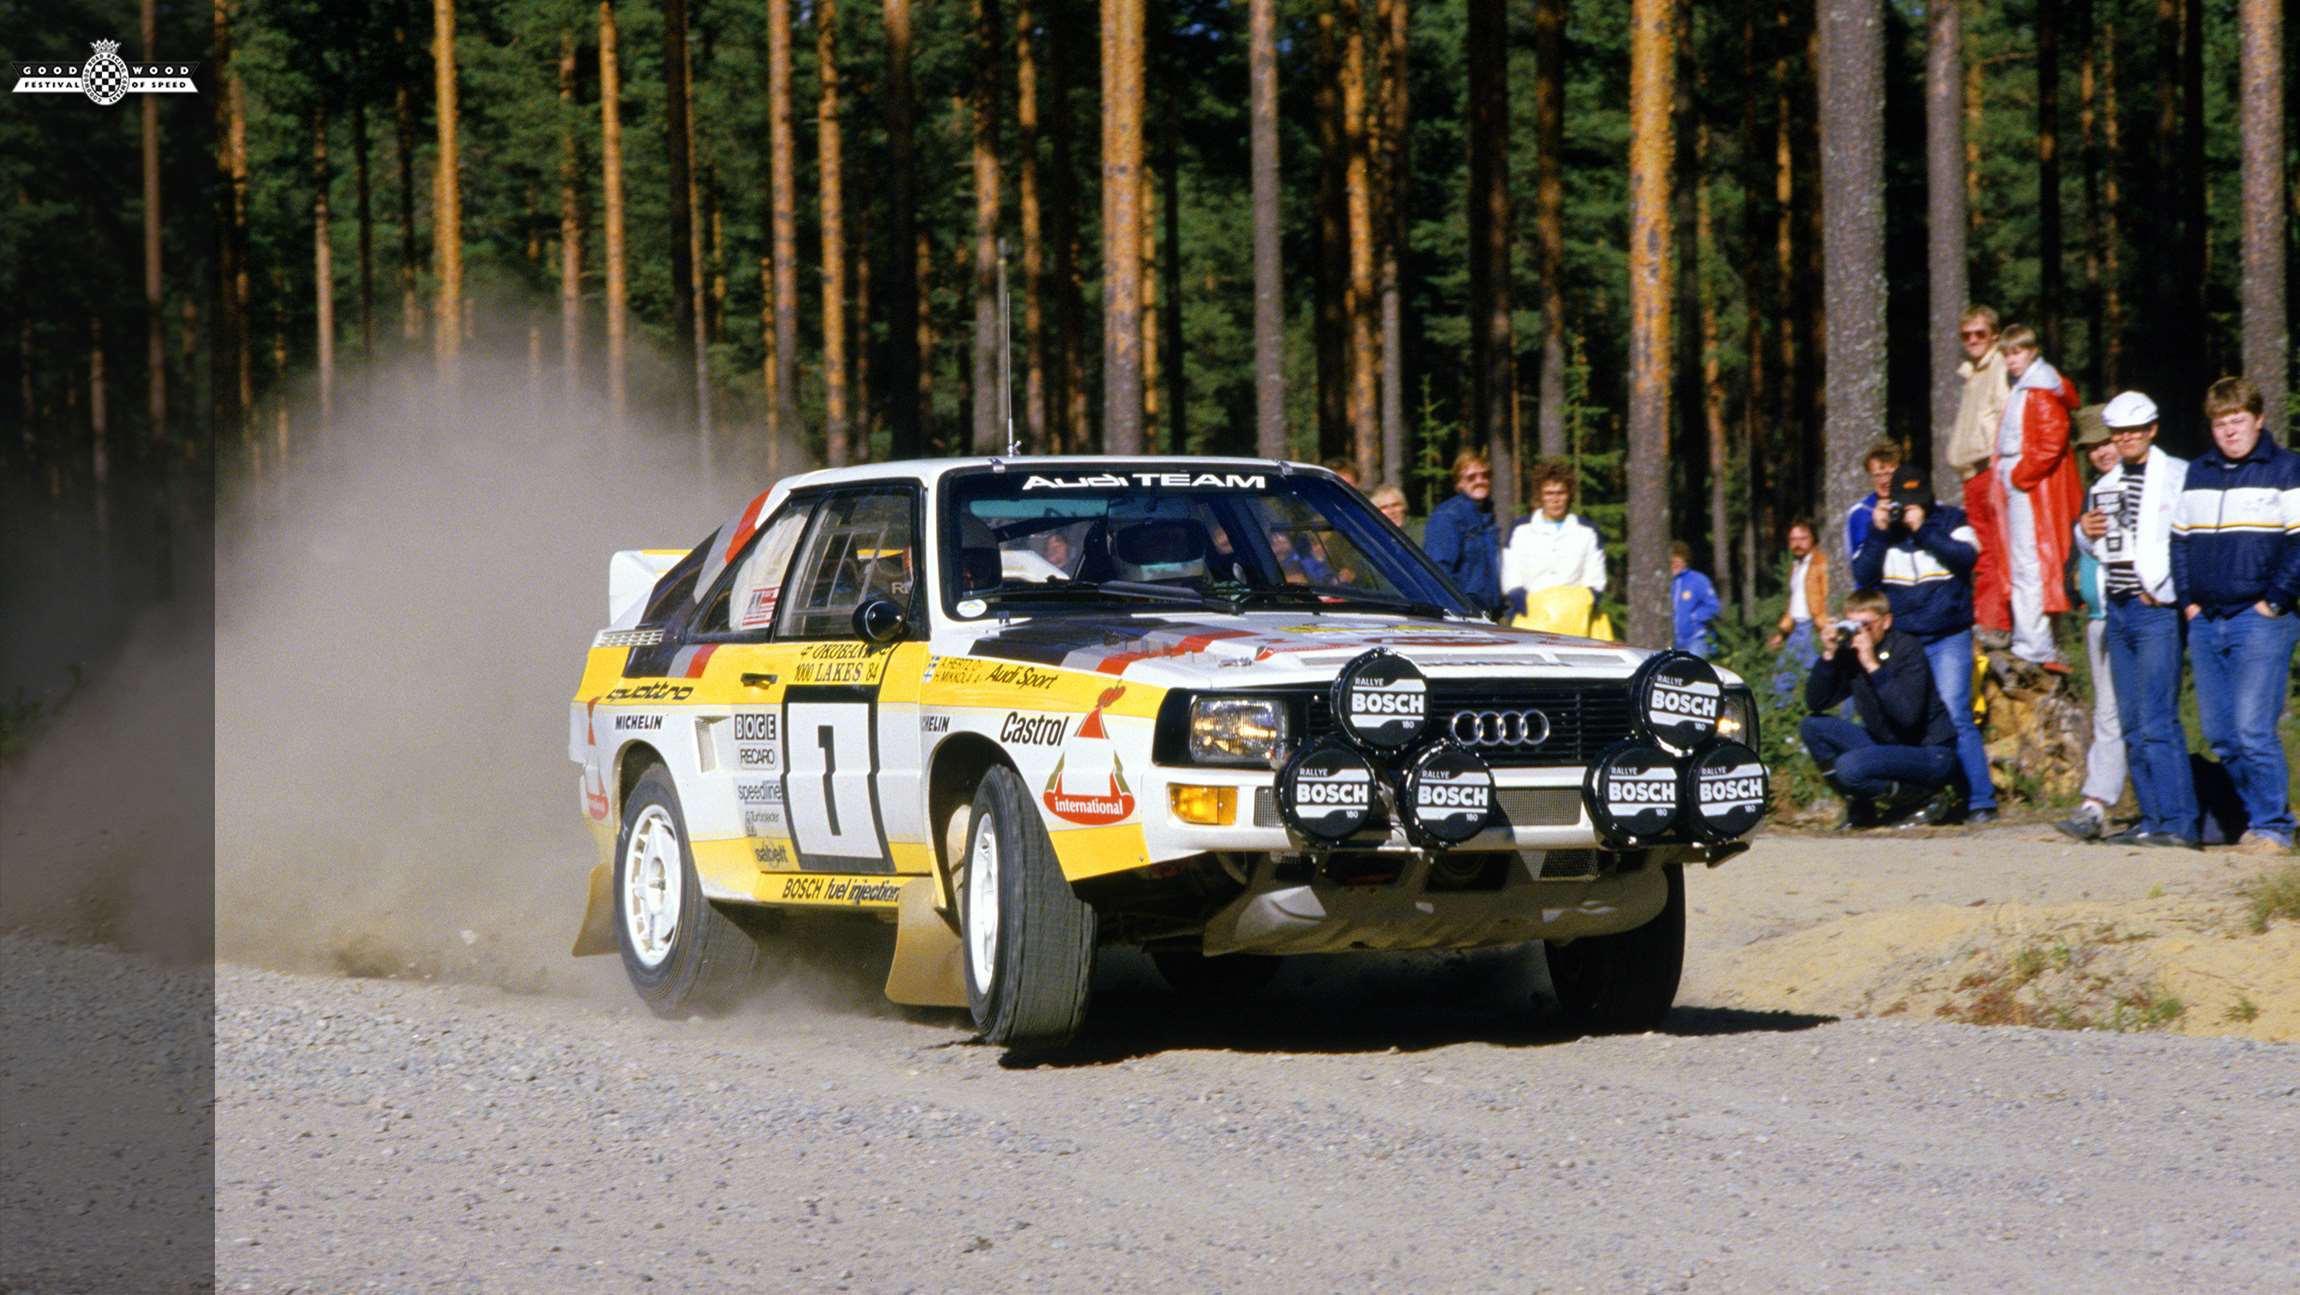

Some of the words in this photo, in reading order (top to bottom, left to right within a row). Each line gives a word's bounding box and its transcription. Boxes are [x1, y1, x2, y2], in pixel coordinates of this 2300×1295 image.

[1132, 473, 1266, 489] TEAM
[815, 662, 864, 682] LAKES
[986, 664, 1023, 684] Audi
[1016, 667, 1058, 690] Sport
[1657, 674, 1684, 686] RALLYE
[606, 681, 694, 702] quattro
[1355, 678, 1384, 687] RALLYE
[1352, 693, 1424, 713] BOSCH
[1651, 689, 1717, 718] BOSCH
[615, 715, 663, 730] MICHELIN
[735, 714, 776, 740] BOGE
[1000, 711, 1070, 746] Castrol
[740, 748, 776, 765] RECARO
[1300, 768, 1328, 777] RALLYE
[1422, 770, 1450, 779] RALLYE
[1611, 767, 1637, 775] RALLYE
[1702, 766, 1727, 775] RALLYE
[818, 725, 842, 836] 1
[738, 783, 783, 802] speedline
[1297, 783, 1369, 804] BOSCH
[1418, 785, 1489, 807] BOSCH
[1609, 782, 1676, 801] BOSCH
[1700, 778, 1763, 803] BOSCH
[1055, 797, 1123, 815] international
[782, 878, 824, 899] BOSCH
[824, 878, 852, 901] fuel
[848, 880, 900, 904] injection
